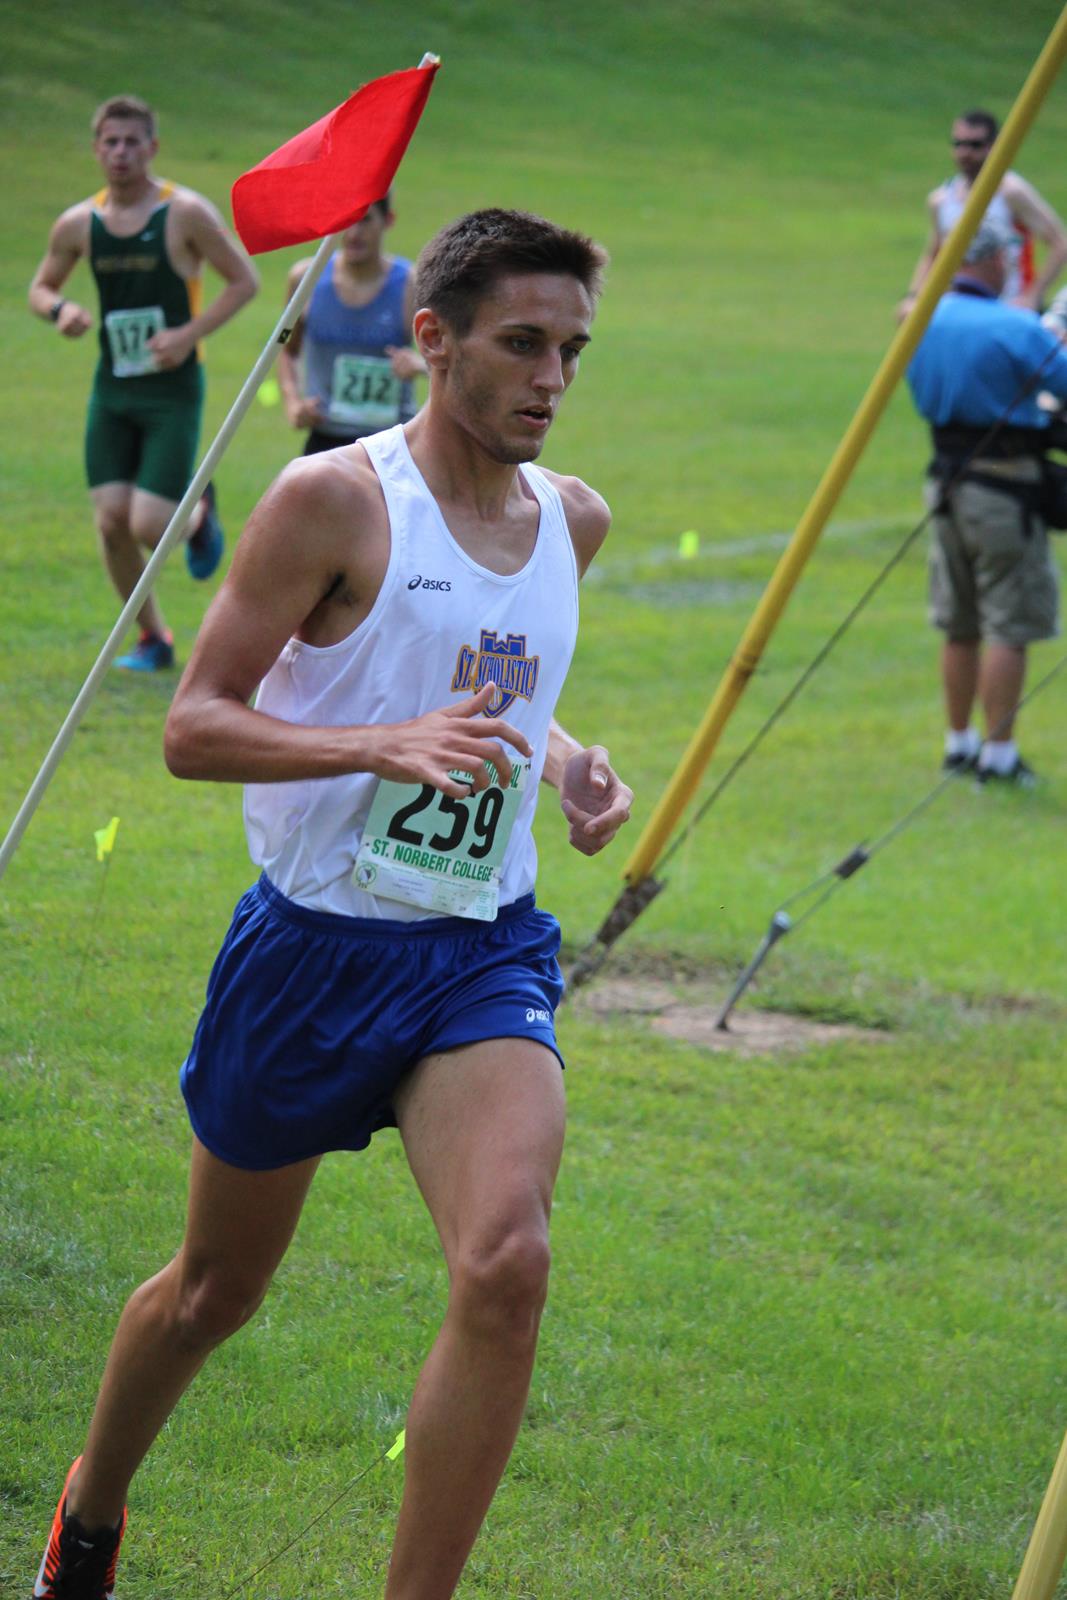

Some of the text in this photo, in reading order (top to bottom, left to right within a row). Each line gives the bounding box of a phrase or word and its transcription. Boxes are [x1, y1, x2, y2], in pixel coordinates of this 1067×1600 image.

[341, 374, 391, 405] 212
[422, 579, 452, 592] asics
[386, 779, 504, 859] 259
[371, 838, 391, 858] ST.
[393, 844, 452, 873] NORBERT
[452, 860, 494, 882] COLLEGE
